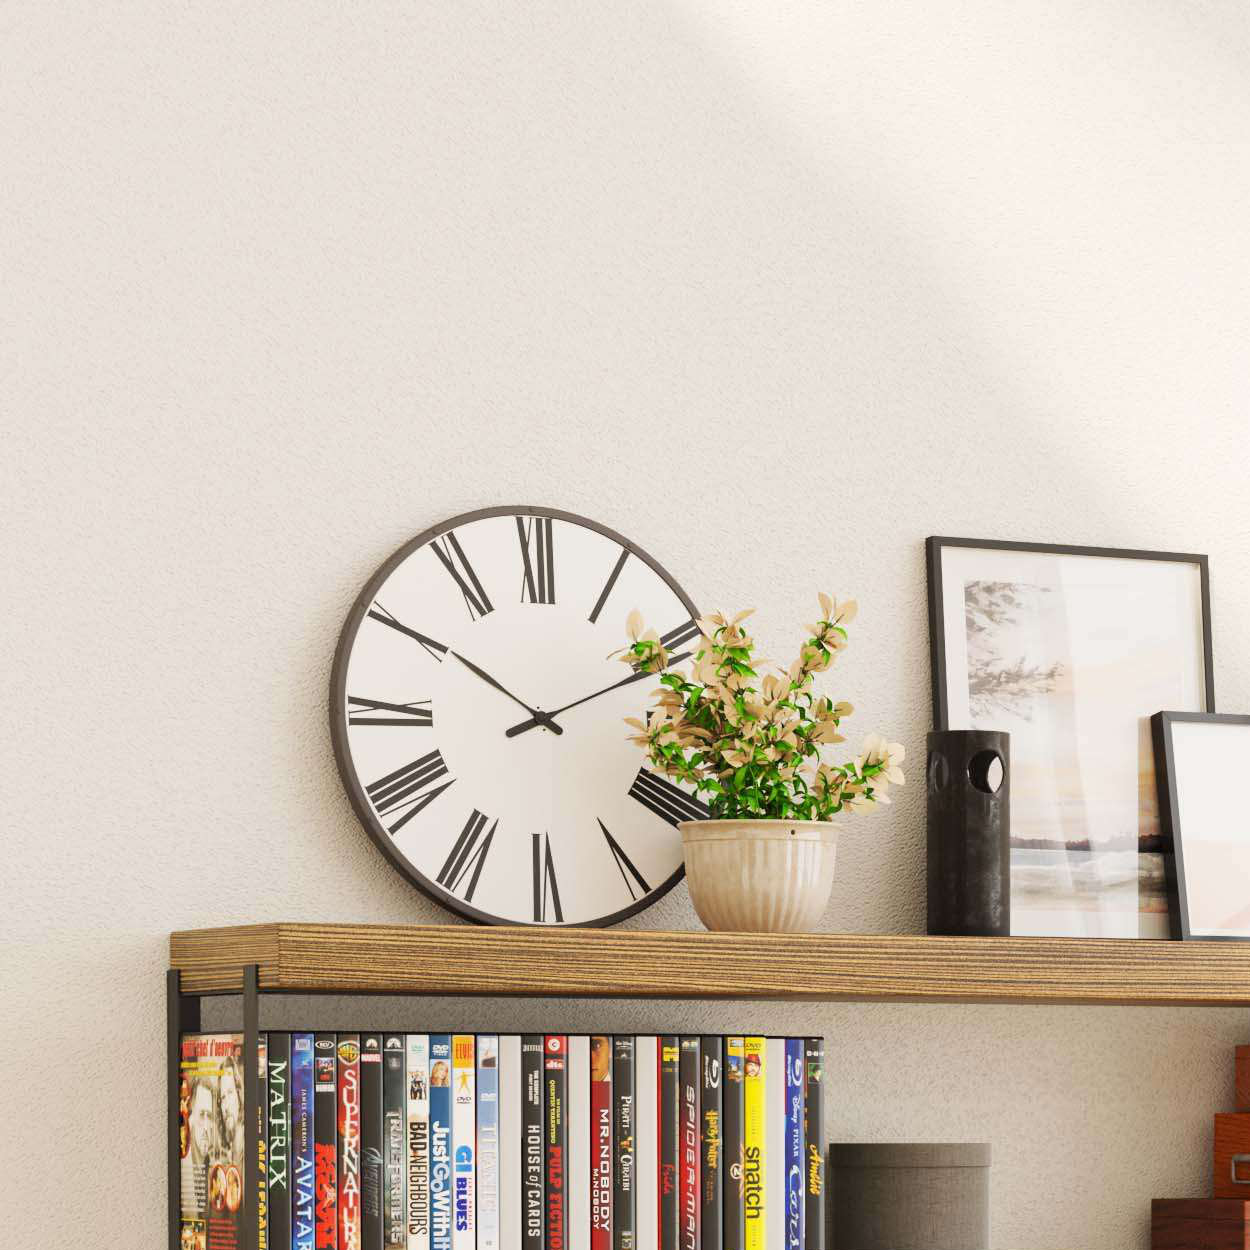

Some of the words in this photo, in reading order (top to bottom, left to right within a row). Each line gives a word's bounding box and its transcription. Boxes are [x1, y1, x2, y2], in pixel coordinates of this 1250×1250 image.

[268, 1061, 287, 1189] MATRIX
[410, 1121, 427, 1151] BAD
[528, 1125, 540, 1173] HOUSE
[410, 1154, 427, 1235] NEIGHBOURS
[525, 1175, 541, 1188] of
[549, 1146, 563, 1188] PULP
[600, 1109, 610, 1231] MR.NOBODY
[686, 1085, 696, 1250] SPIDER-MAN
[745, 1146, 764, 1219] snatch
[456, 1177, 468, 1231] BLUES
[528, 1190, 540, 1237] CARDS
[789, 1164, 803, 1249] Cars
